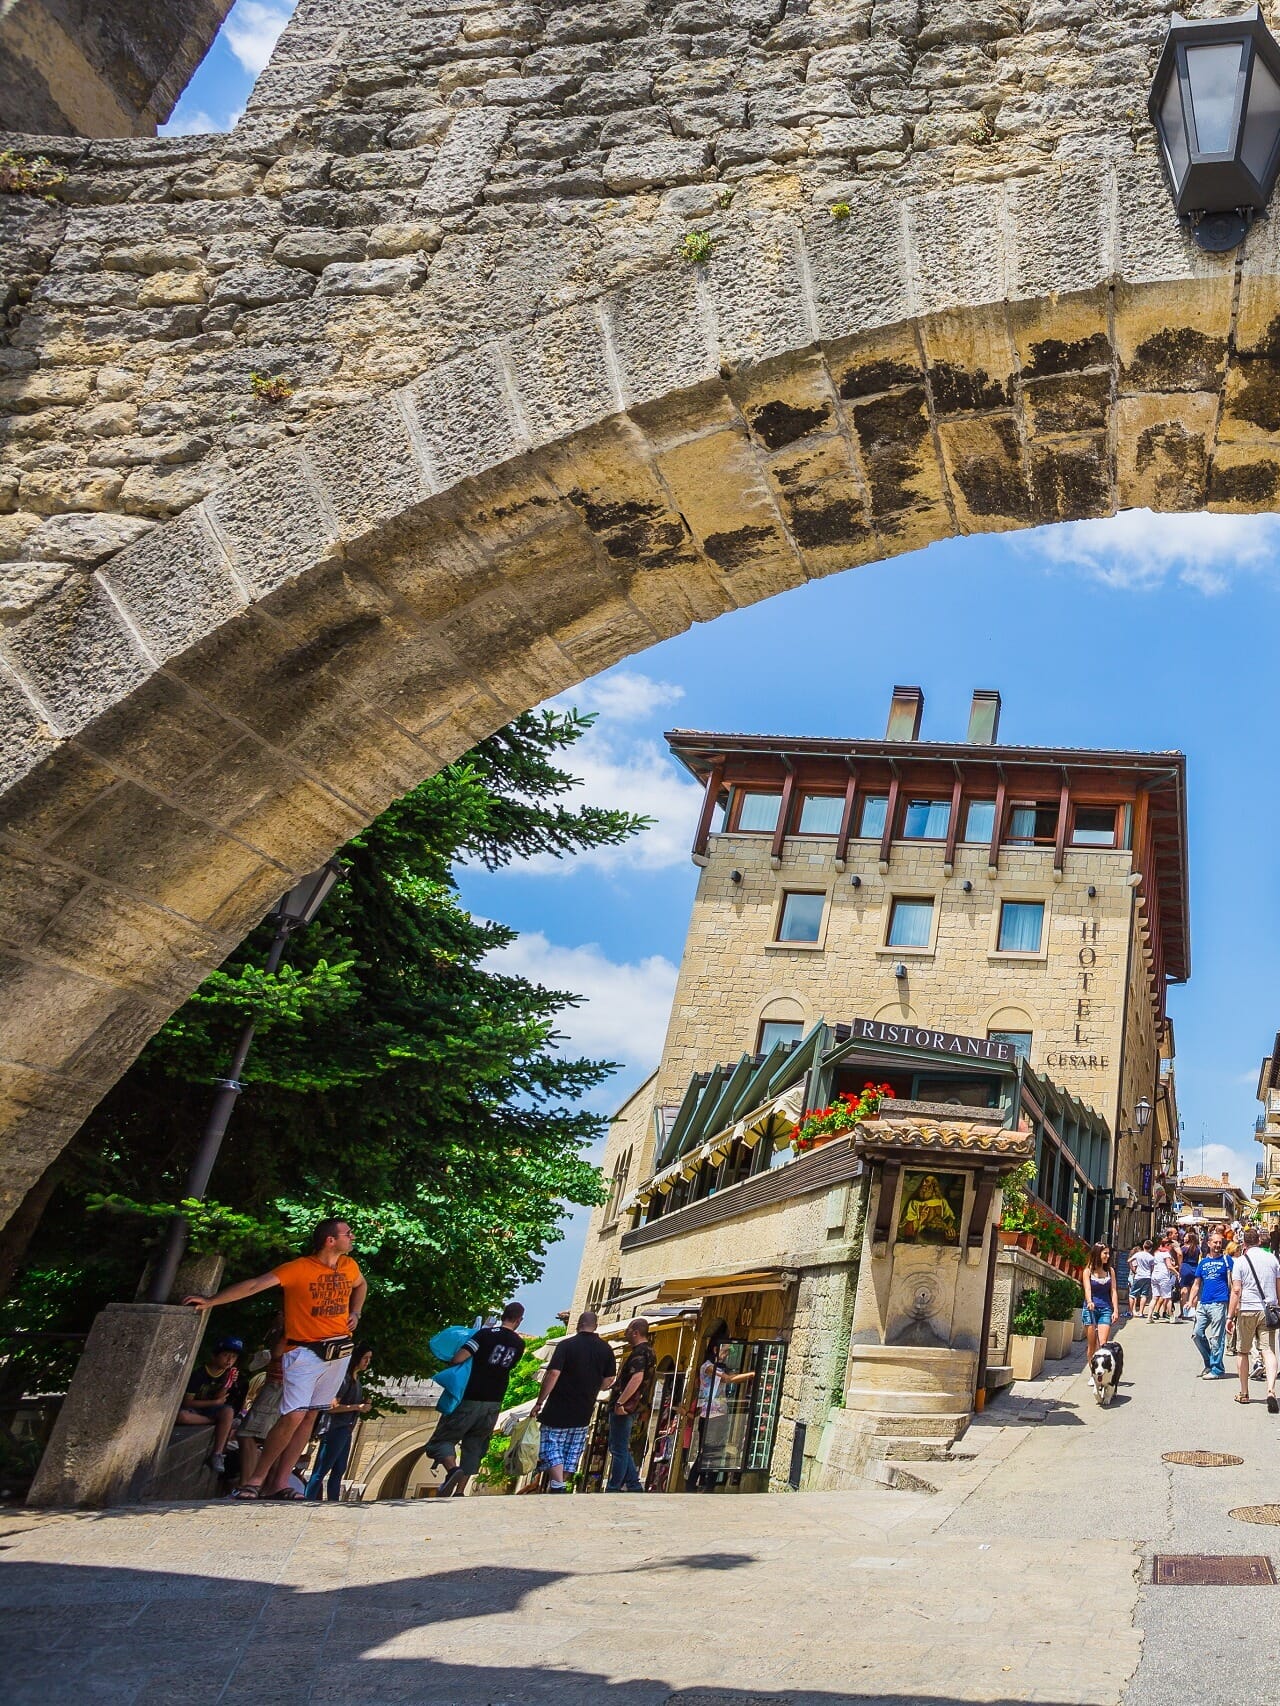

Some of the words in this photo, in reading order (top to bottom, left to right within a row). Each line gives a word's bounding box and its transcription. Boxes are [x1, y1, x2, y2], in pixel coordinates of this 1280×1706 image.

[1074, 922, 1098, 1043] HOTEL
[862, 1021, 1010, 1060] RISTORANTE
[1046, 1053, 1110, 1068] CESARE
